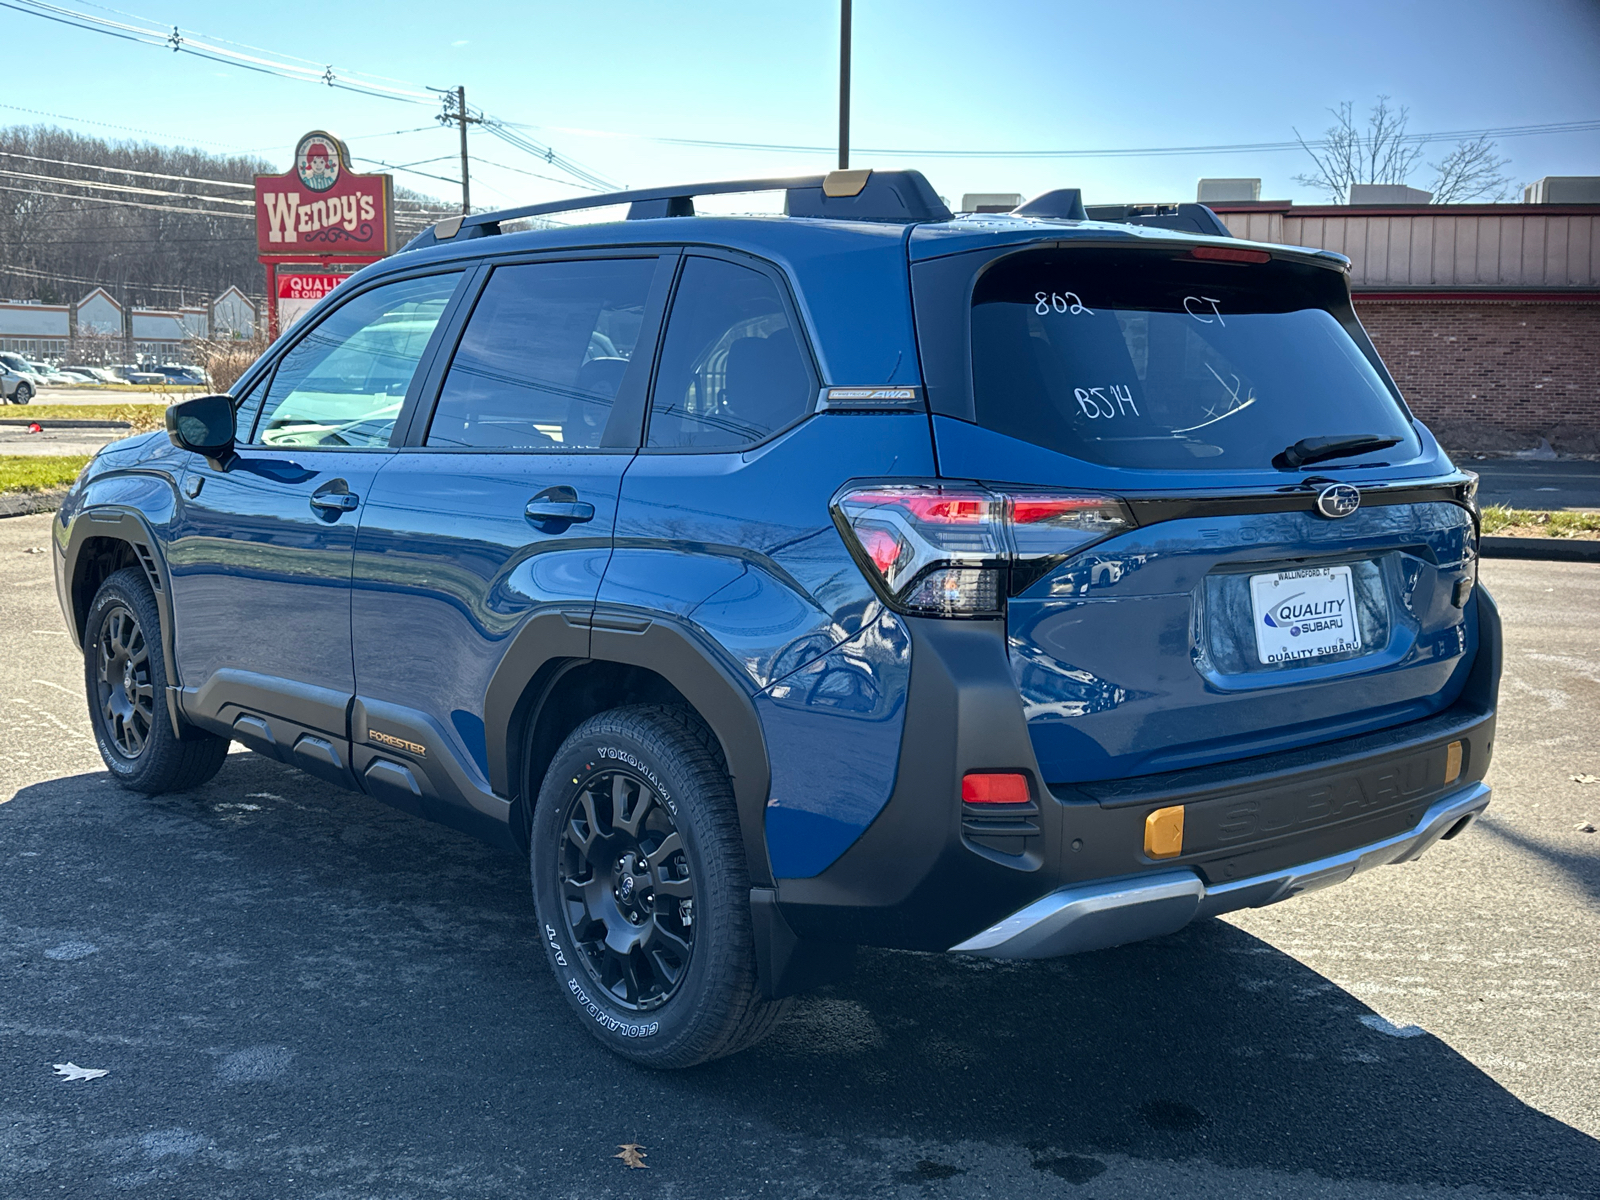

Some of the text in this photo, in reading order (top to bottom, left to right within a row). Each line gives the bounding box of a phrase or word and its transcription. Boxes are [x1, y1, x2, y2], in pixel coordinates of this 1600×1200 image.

[291, 290, 300, 298] IS
[302, 290, 322, 298] OUR
[1034, 291, 1095, 316] 802
[1183, 296, 1225, 327] CT
[1323, 568, 1331, 576] CT
[1279, 599, 1345, 620] QUALITY
[1301, 618, 1343, 633] SUBARU
[1267, 641, 1359, 663] QUALITY SUBARU
[369, 729, 426, 756] FORESTER
[597, 747, 678, 816] YOKOHAMA
[1217, 758, 1429, 841] SUBARU
[545, 924, 659, 1038] GEOLANDAR A/T
